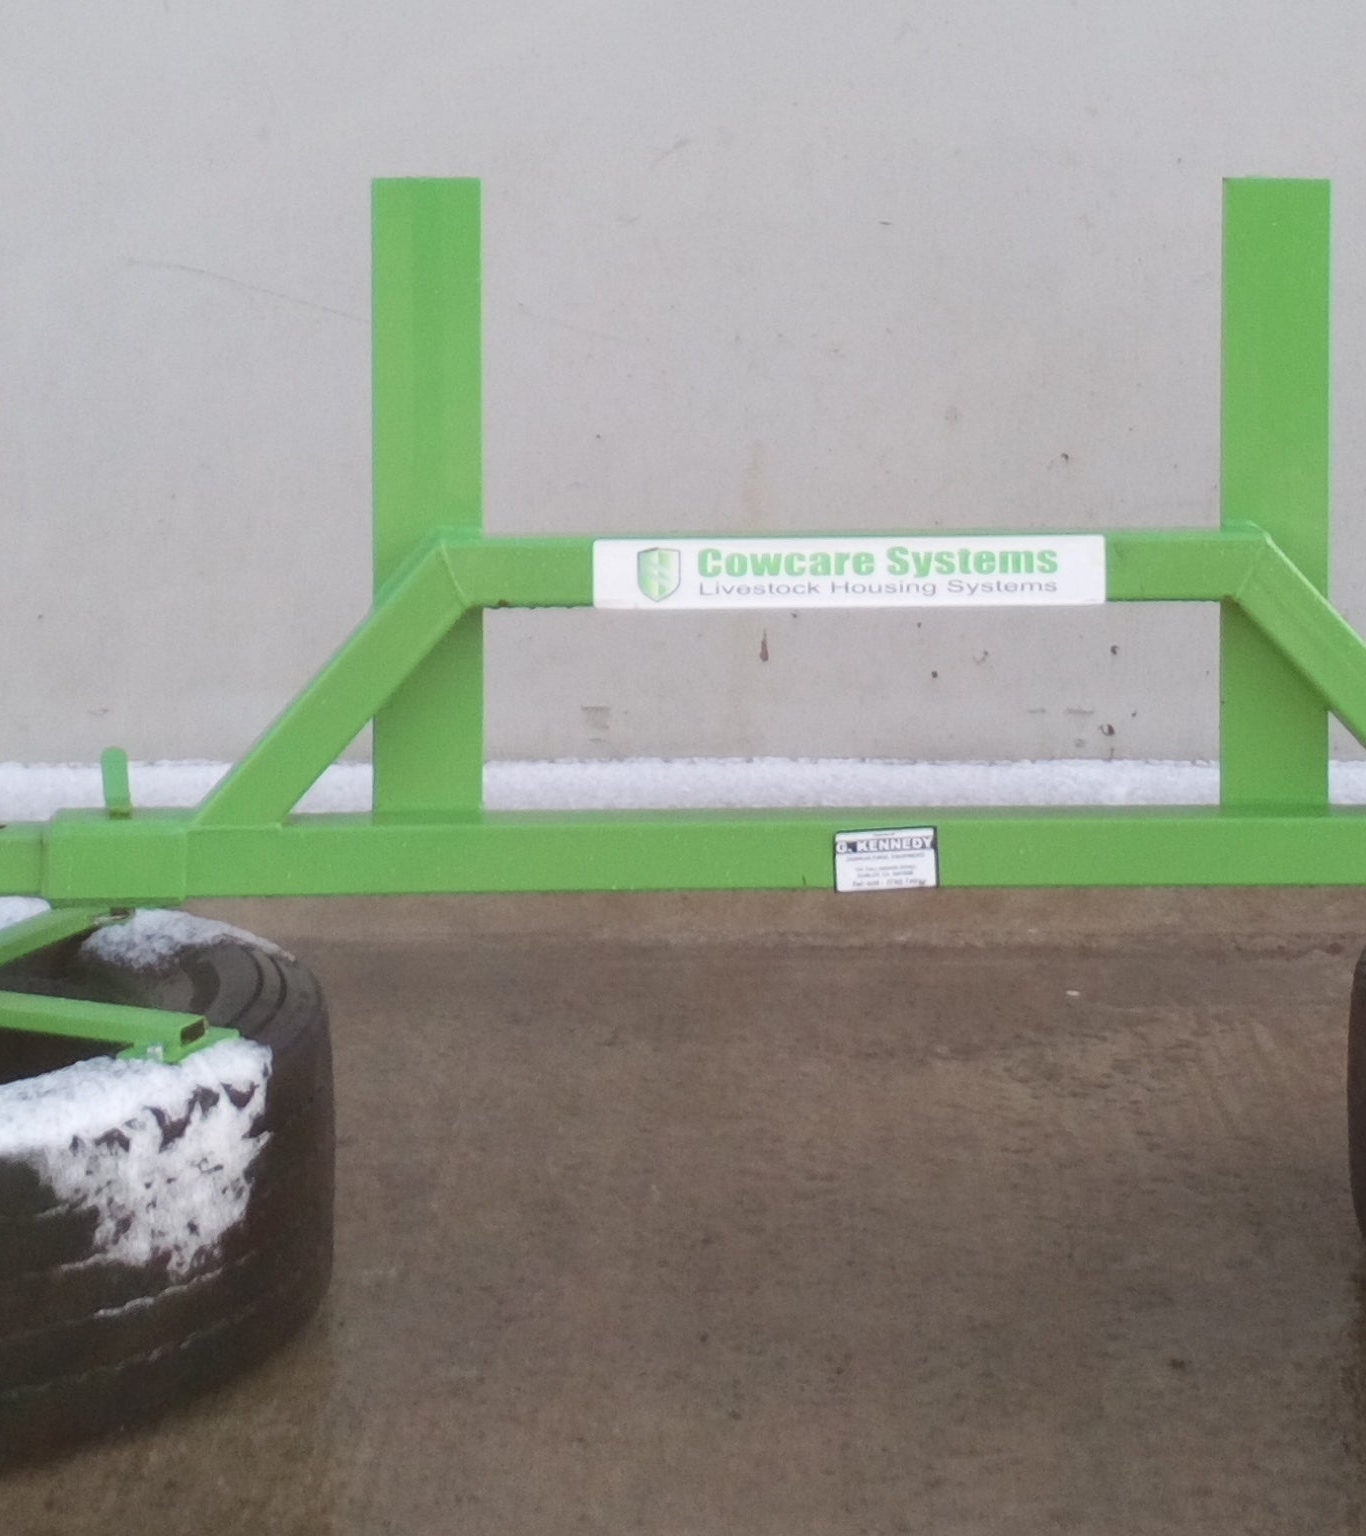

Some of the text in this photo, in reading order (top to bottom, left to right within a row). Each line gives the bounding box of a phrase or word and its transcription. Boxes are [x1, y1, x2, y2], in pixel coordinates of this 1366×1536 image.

[697, 545, 1059, 578] Cowcare Systems
[699, 579, 1058, 597] Livestock Housing Systems
[856, 836, 932, 853] KENNEDY
